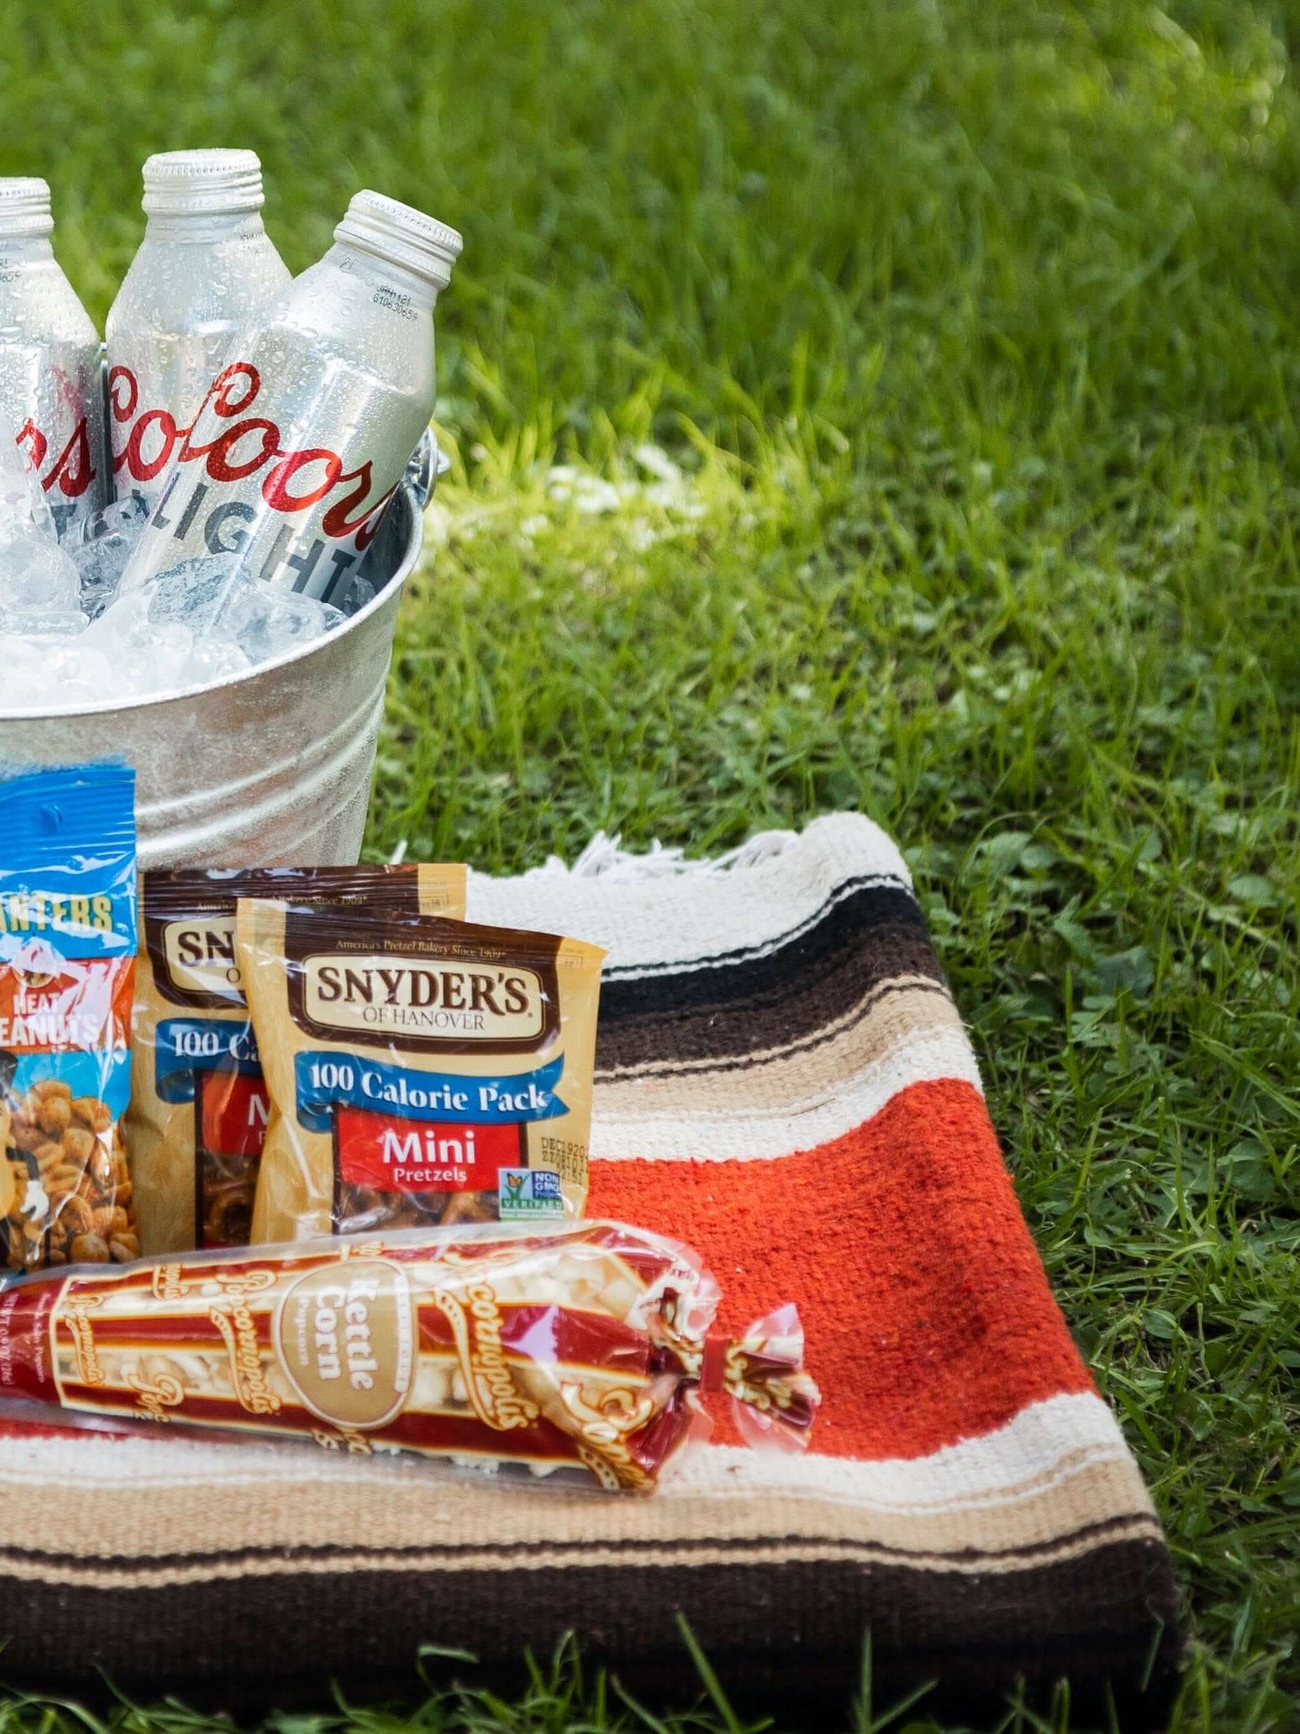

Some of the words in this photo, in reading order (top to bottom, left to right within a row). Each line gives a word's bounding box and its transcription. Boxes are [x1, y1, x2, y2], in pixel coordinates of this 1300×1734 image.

[150, 470, 358, 604] LIGHT
[384, 940, 416, 952] Pretzel
[418, 942, 451, 955] Bakery
[316, 966, 528, 1018] SNYDER'S
[363, 1006, 391, 1022] OF
[393, 1008, 485, 1031] HANOVER
[174, 1031, 220, 1057] 100
[310, 1063, 355, 1091] 100
[361, 1072, 469, 1111] Calorie
[479, 1083, 549, 1112] Pack
[382, 1129, 476, 1164] Mini
[394, 1167, 468, 1183] Pretzels
[535, 1172, 560, 1184] NON
[535, 1182, 560, 1193] GMO
[504, 1200, 563, 1210] VERIFIED
[216, 1270, 282, 1415] Popcornopolis
[314, 1285, 347, 1381] Corn
[345, 1278, 381, 1391] Kettle
